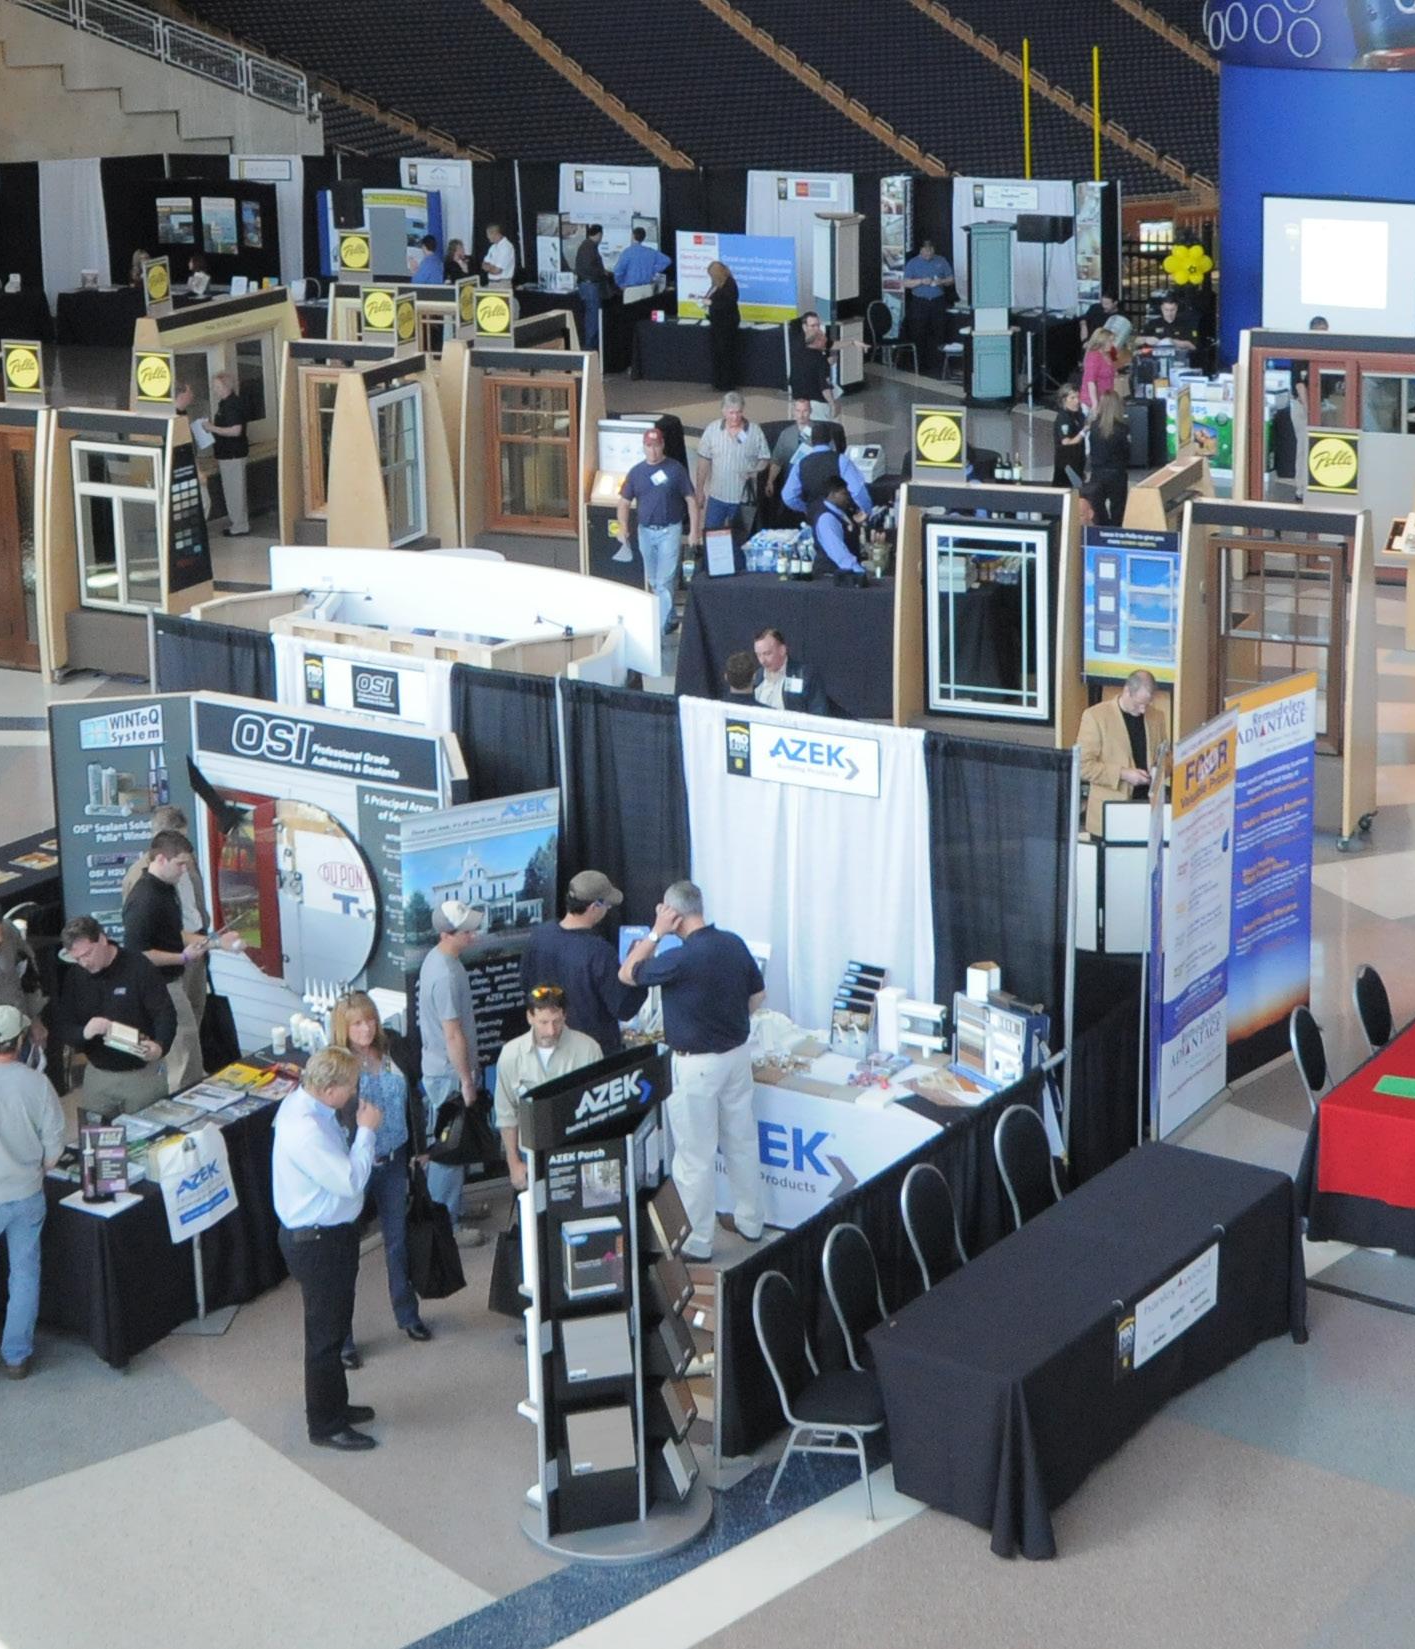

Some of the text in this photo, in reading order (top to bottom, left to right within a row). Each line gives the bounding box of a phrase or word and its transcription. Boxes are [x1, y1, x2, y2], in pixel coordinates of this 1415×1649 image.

[366, 301, 393, 317] Pella
[479, 304, 507, 322] Pella
[8, 360, 36, 375] Pella
[140, 368, 168, 382] Pella
[921, 426, 962, 449] Pella
[1313, 449, 1355, 471] Pella
[356, 673, 394, 696] OSI
[109, 708, 159, 730] WINTeQ
[1252, 699, 1306, 725] Remodelers
[111, 729, 160, 746] System
[1238, 710, 1306, 744] ADVANTAGE
[231, 713, 311, 764] OSI
[311, 743, 391, 766] Professional Grade
[769, 737, 846, 769] AZEK
[311, 757, 400, 780] Adhesives & Sealants
[363, 794, 370, 804] 5
[370, 796, 408, 811] Principal
[501, 795, 550, 817] AZEK
[94, 822, 127, 833] Sealant
[129, 820, 152, 831] Solut
[377, 811, 387, 820] of
[123, 831, 152, 841] Windo
[323, 864, 363, 888] DUPON
[575, 1068, 644, 1119] AZEK
[548, 1148, 606, 1165] AZEK Porch
[757, 1119, 831, 1177] EK
[176, 1158, 220, 1197] AZEK
